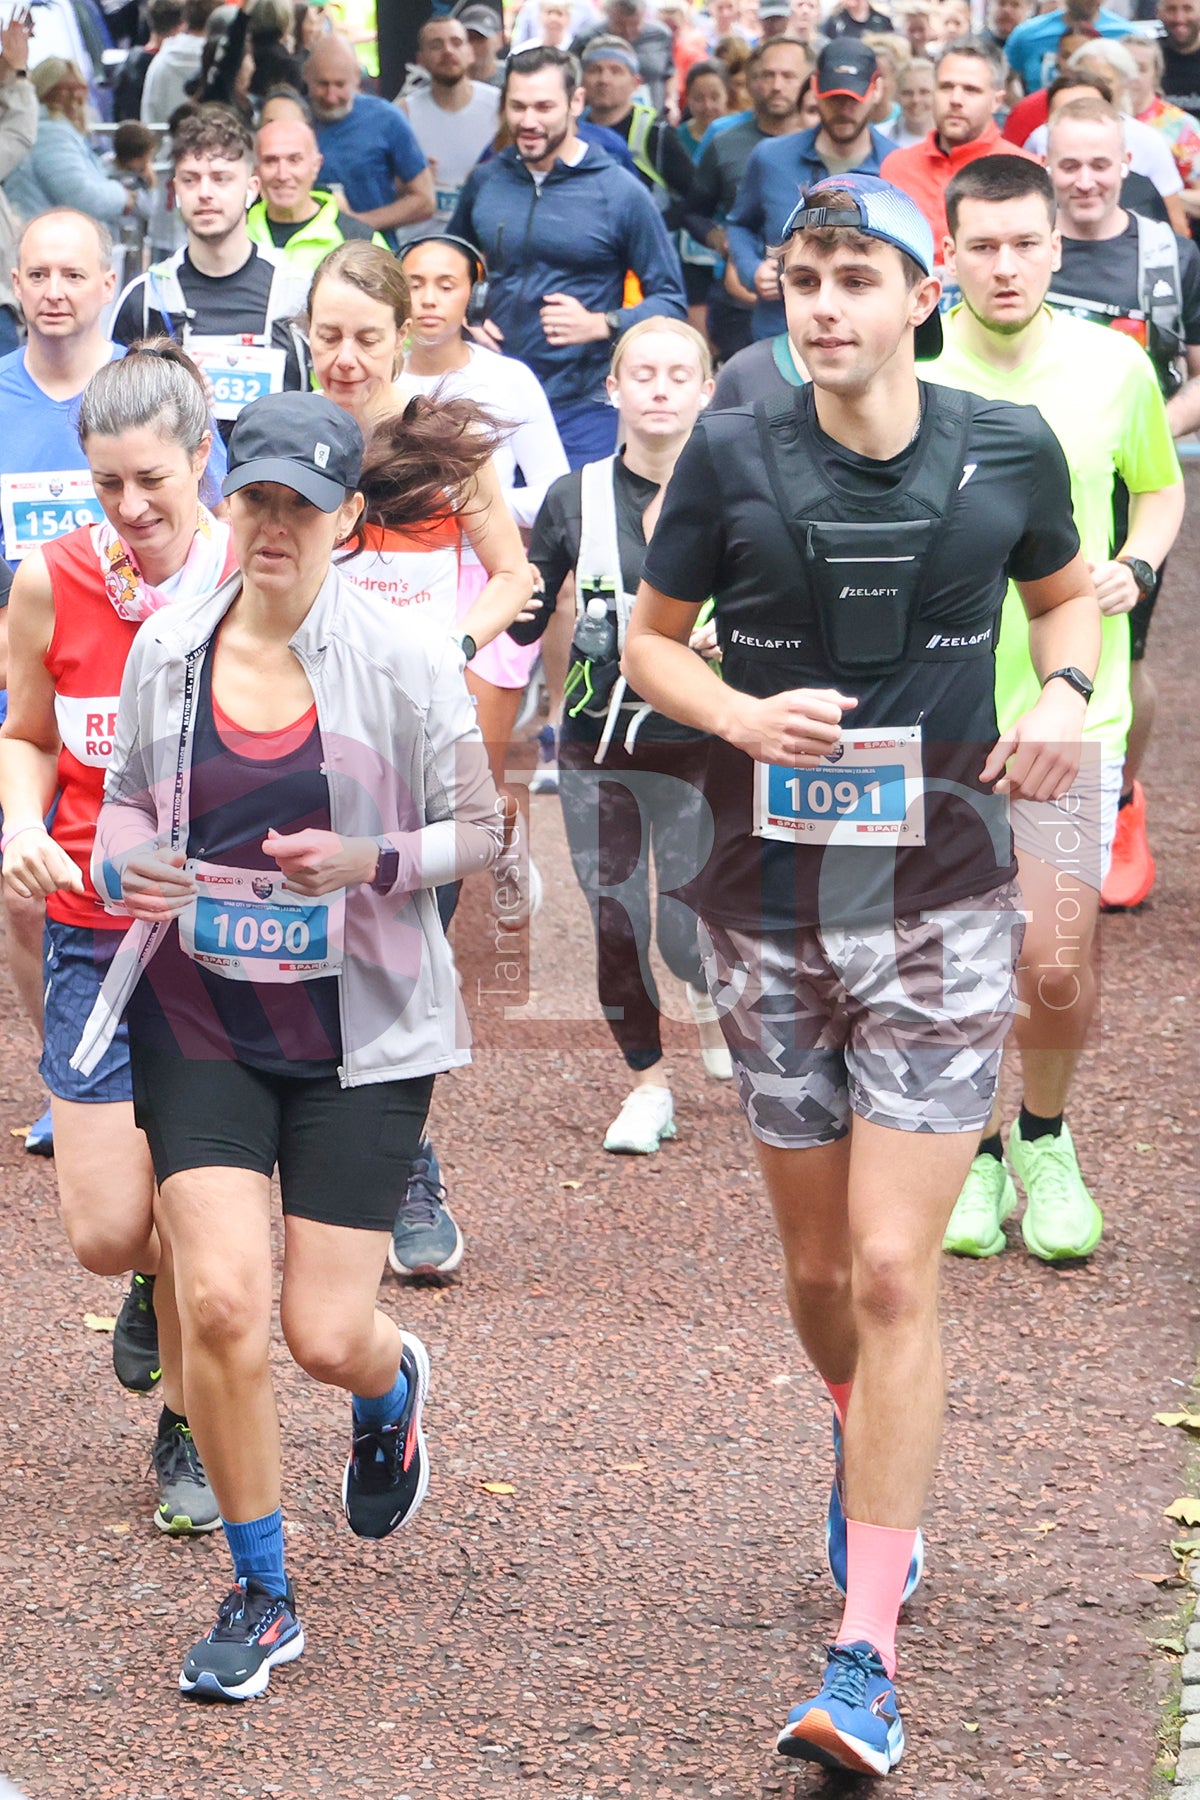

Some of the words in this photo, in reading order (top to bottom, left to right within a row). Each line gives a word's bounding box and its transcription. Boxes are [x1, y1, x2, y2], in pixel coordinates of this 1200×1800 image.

[213, 377, 262, 404] 632
[25, 509, 94, 537] 1549
[348, 575, 409, 593] ildren's
[847, 587, 899, 597] ZELAFIT
[738, 634, 802, 648] ZELAFIT
[186, 685, 194, 694] LA
[182, 698, 192, 726] NATION
[85, 713, 118, 737] RE
[85, 741, 113, 755] RO
[863, 740, 896, 748] SPAR
[784, 777, 881, 815] 1091
[173, 792, 182, 820] NATION
[776, 819, 806, 830] SPAR
[865, 824, 899, 832] SPAR
[203, 874, 233, 884] SPAR
[213, 913, 310, 955] 1090
[202, 955, 231, 966] SPAR
[288, 963, 319, 971] SPAR
